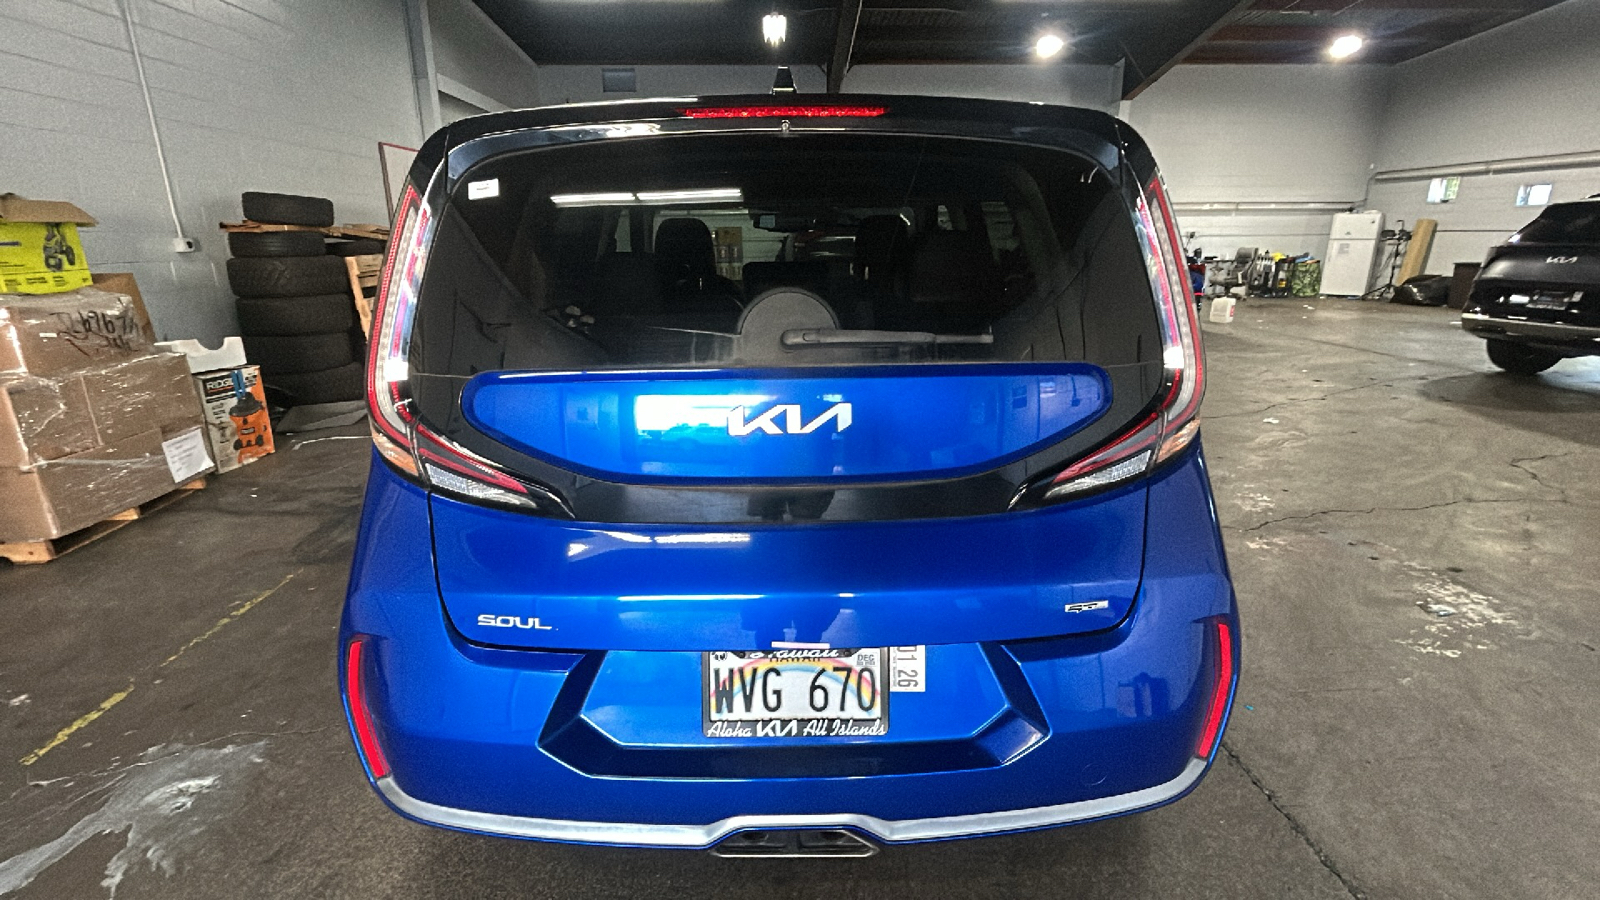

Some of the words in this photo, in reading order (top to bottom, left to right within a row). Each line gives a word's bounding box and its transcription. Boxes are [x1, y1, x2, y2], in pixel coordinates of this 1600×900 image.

[727, 402, 852, 436] KIA
[477, 613, 553, 631] SOUL
[856, 653, 875, 663] DEC
[897, 669, 919, 688] 26
[713, 667, 782, 714] WVG
[808, 667, 876, 713] 670
[706, 721, 752, 738] Aloha
[756, 719, 798, 737] KIA
[802, 719, 828, 737] All
[829, 718, 886, 737] Islands
